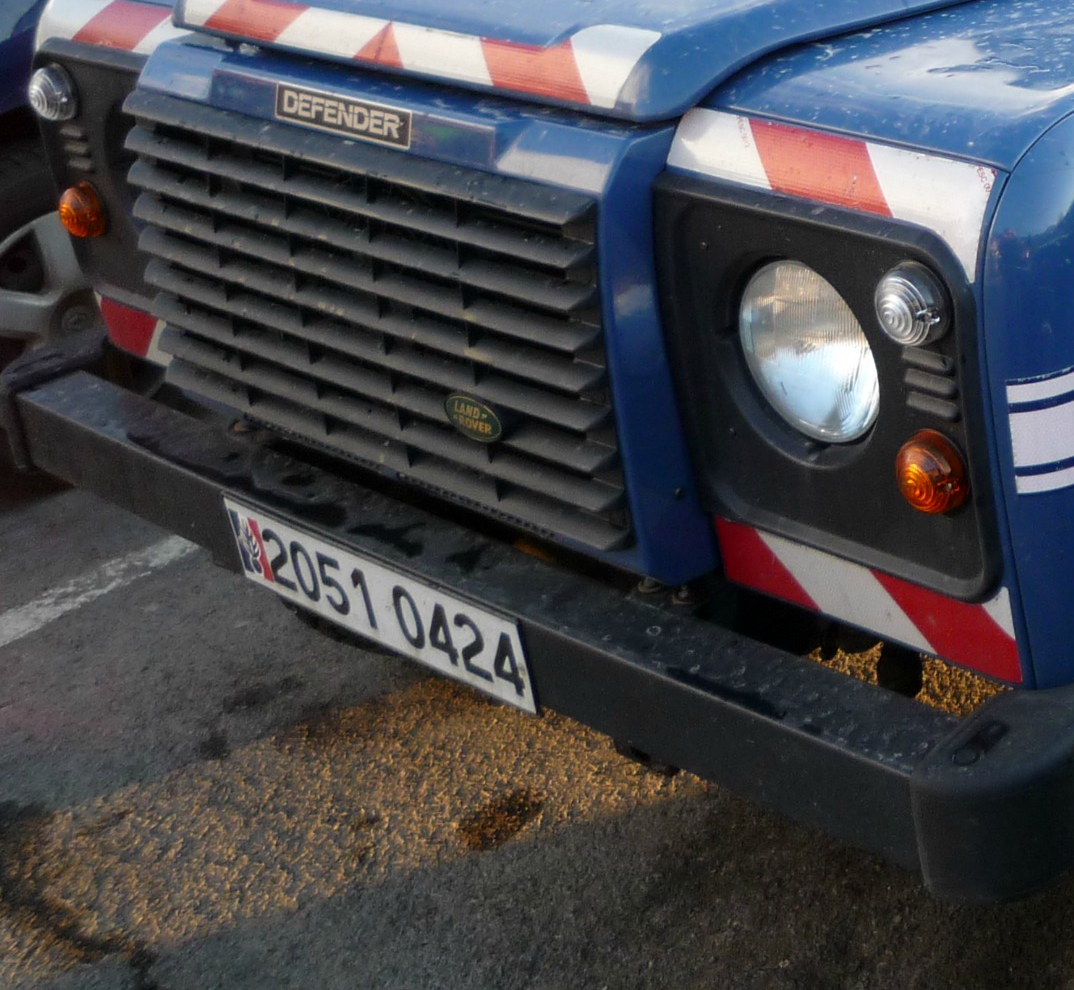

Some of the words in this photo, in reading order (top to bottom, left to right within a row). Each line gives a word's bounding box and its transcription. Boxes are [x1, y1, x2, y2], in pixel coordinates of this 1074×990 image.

[282, 89, 401, 139] DEFENDER
[458, 414, 492, 435] ROVER
[262, 528, 378, 630] 2051
[392, 584, 525, 697] 0424
